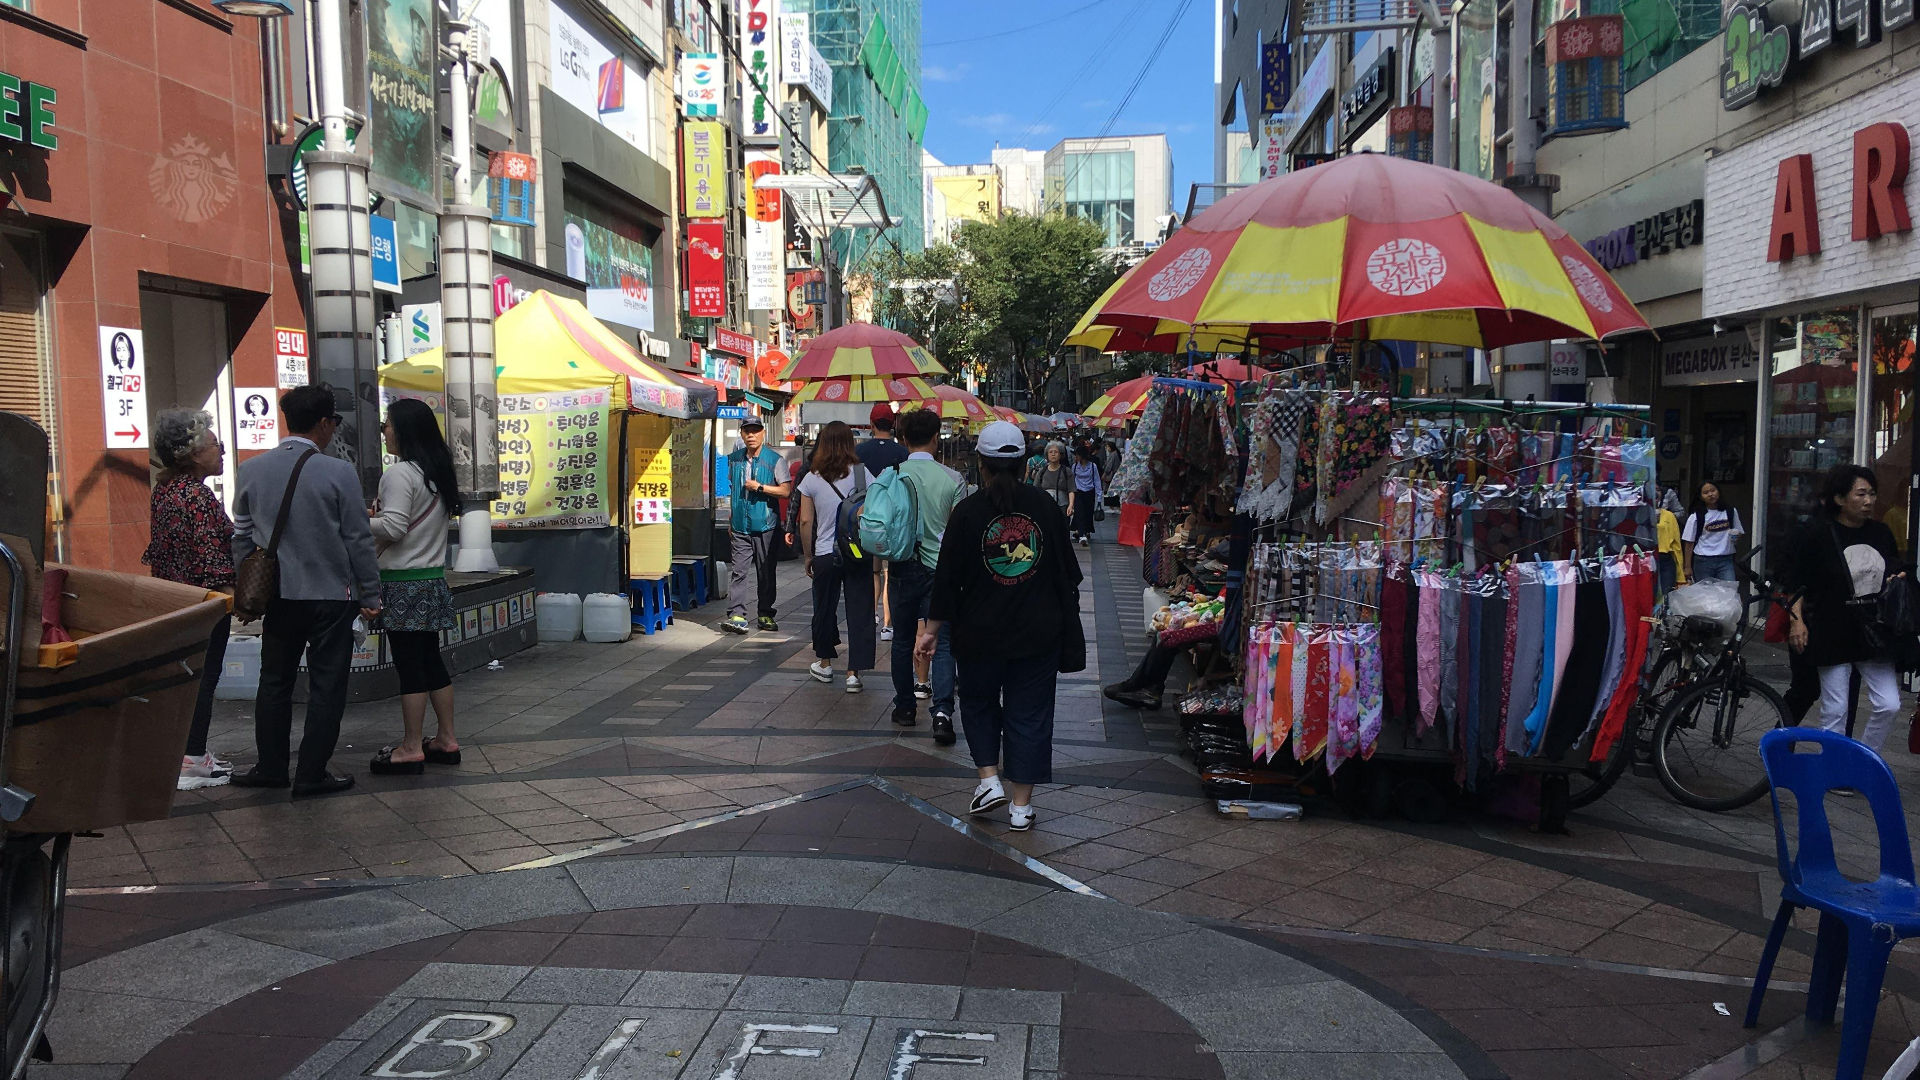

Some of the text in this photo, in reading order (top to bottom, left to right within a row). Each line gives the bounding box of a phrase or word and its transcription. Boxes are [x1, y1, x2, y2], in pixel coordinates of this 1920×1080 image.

[1634, 203, 1701, 260] 부산극장
[277, 331, 305, 355] 임대
[1665, 340, 1760, 376] MEGABOX 부산
[119, 399, 133, 416] 3F
[719, 408, 740, 417] ATM
[557, 410, 599, 431] 취업운
[252, 433, 265, 443] 3F
[556, 452, 598, 471] 승진운
[553, 472, 597, 492] 결혼운
[637, 483, 668, 497] 직장운
[495, 492, 600, 515] 택일 건강운
